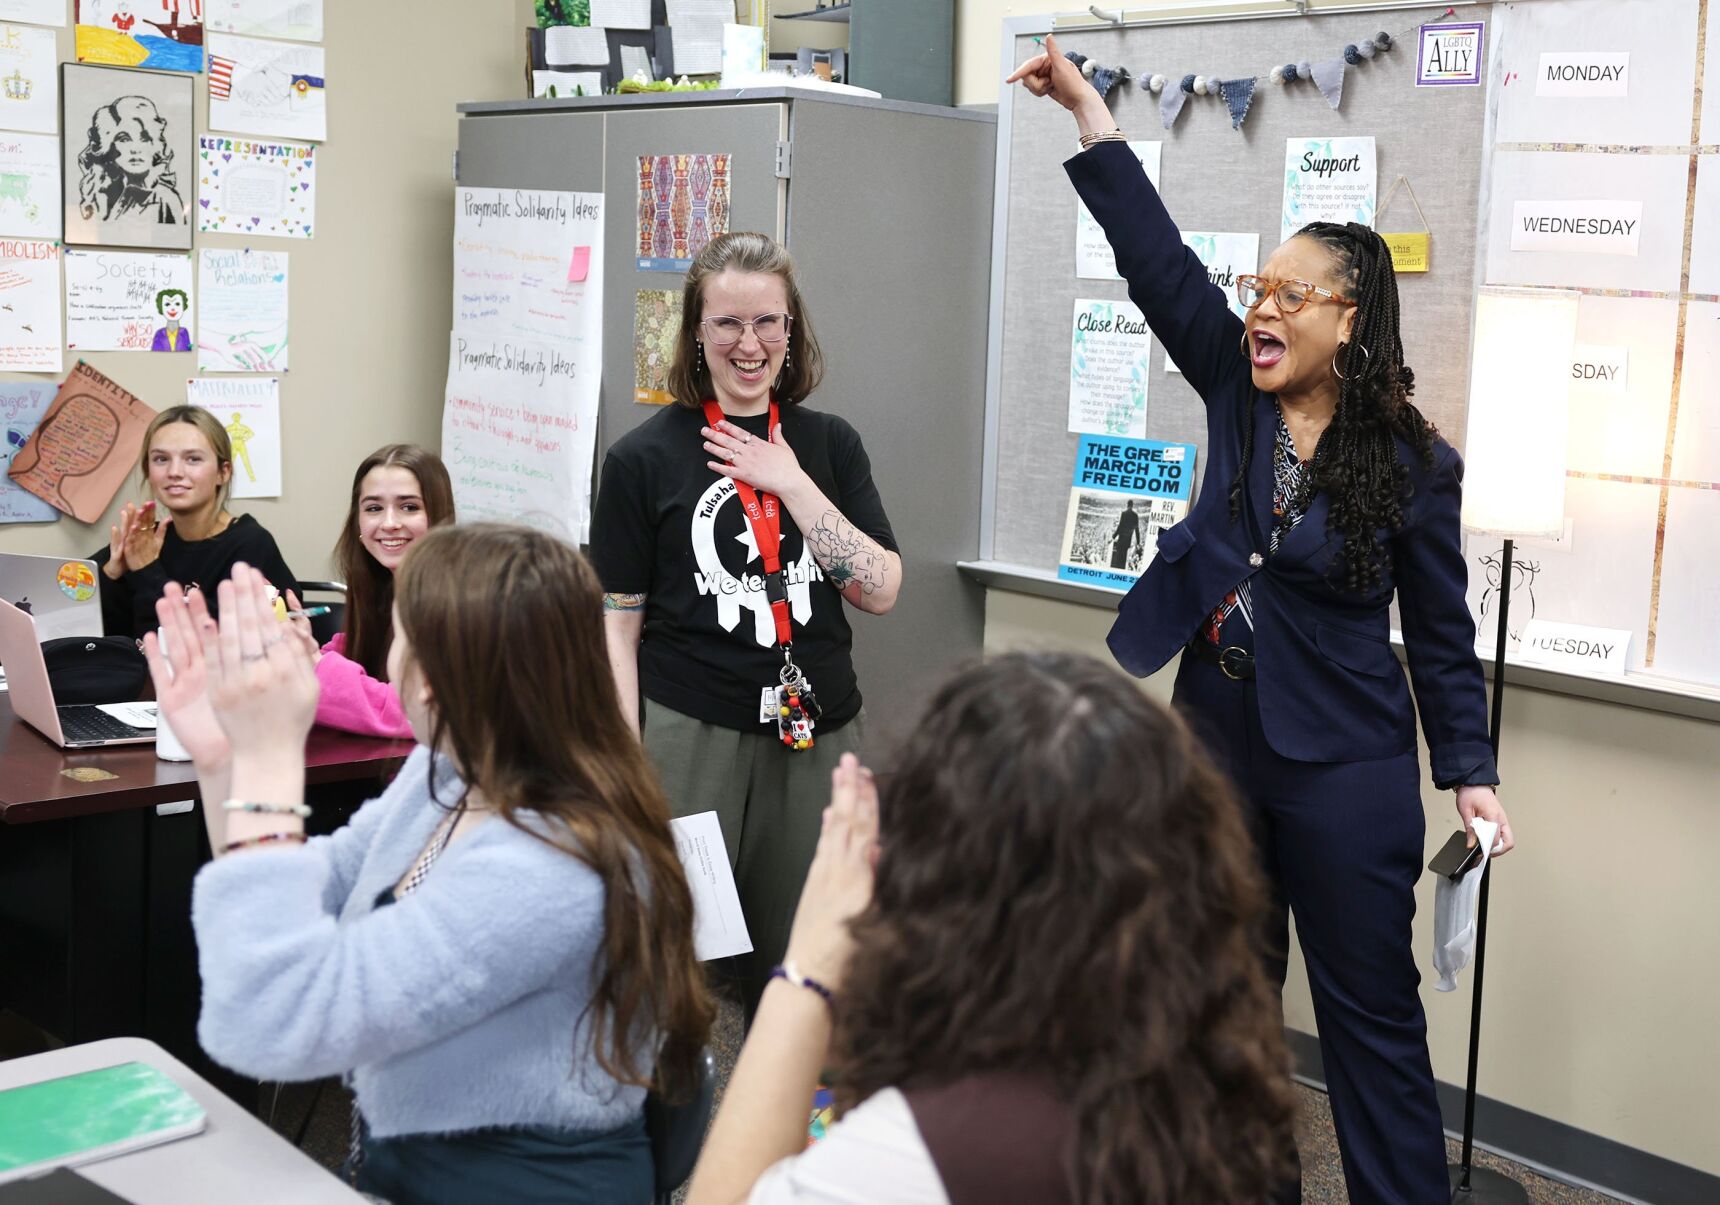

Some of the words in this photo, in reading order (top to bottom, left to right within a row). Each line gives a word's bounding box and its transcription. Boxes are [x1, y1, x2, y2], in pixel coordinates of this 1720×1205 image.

[1443, 36, 1473, 48] LGBTQ
[1427, 37, 1472, 72] ALLY
[1547, 65, 1624, 81] MONDAY
[1300, 151, 1361, 178] Support
[464, 192, 511, 227] Pragmatic
[515, 190, 566, 225] Solidarity
[572, 194, 599, 221] Ideas
[1523, 217, 1636, 235] WEDNESDAY
[204, 249, 240, 270] Social
[1393, 245, 1411, 254] this
[96, 254, 172, 286] Society
[1392, 257, 1422, 266] oment
[215, 268, 273, 287] Relations
[1204, 264, 1235, 288] hink
[1077, 312, 1112, 333] Close
[1114, 314, 1148, 335] Read
[457, 338, 502, 372] Pragmatic
[504, 344, 546, 387] Solidarity
[550, 349, 576, 379] Ideas
[1572, 363, 1619, 381] SDAY
[75, 363, 140, 406] IDENTITY
[1087, 442, 1121, 457] THE
[1084, 457, 1149, 475] MARCH
[1157, 464, 1181, 479] TO
[1082, 471, 1180, 494] FREEDOM
[700, 493, 722, 520] Tulsa
[1162, 501, 1176, 512] REV.
[1150, 512, 1175, 525] MARTIN
[693, 570, 738, 596] We
[741, 560, 805, 593] teh
[1067, 566, 1103, 578] DETROIT
[1106, 573, 1128, 582] JUNE
[793, 723, 797, 731] I
